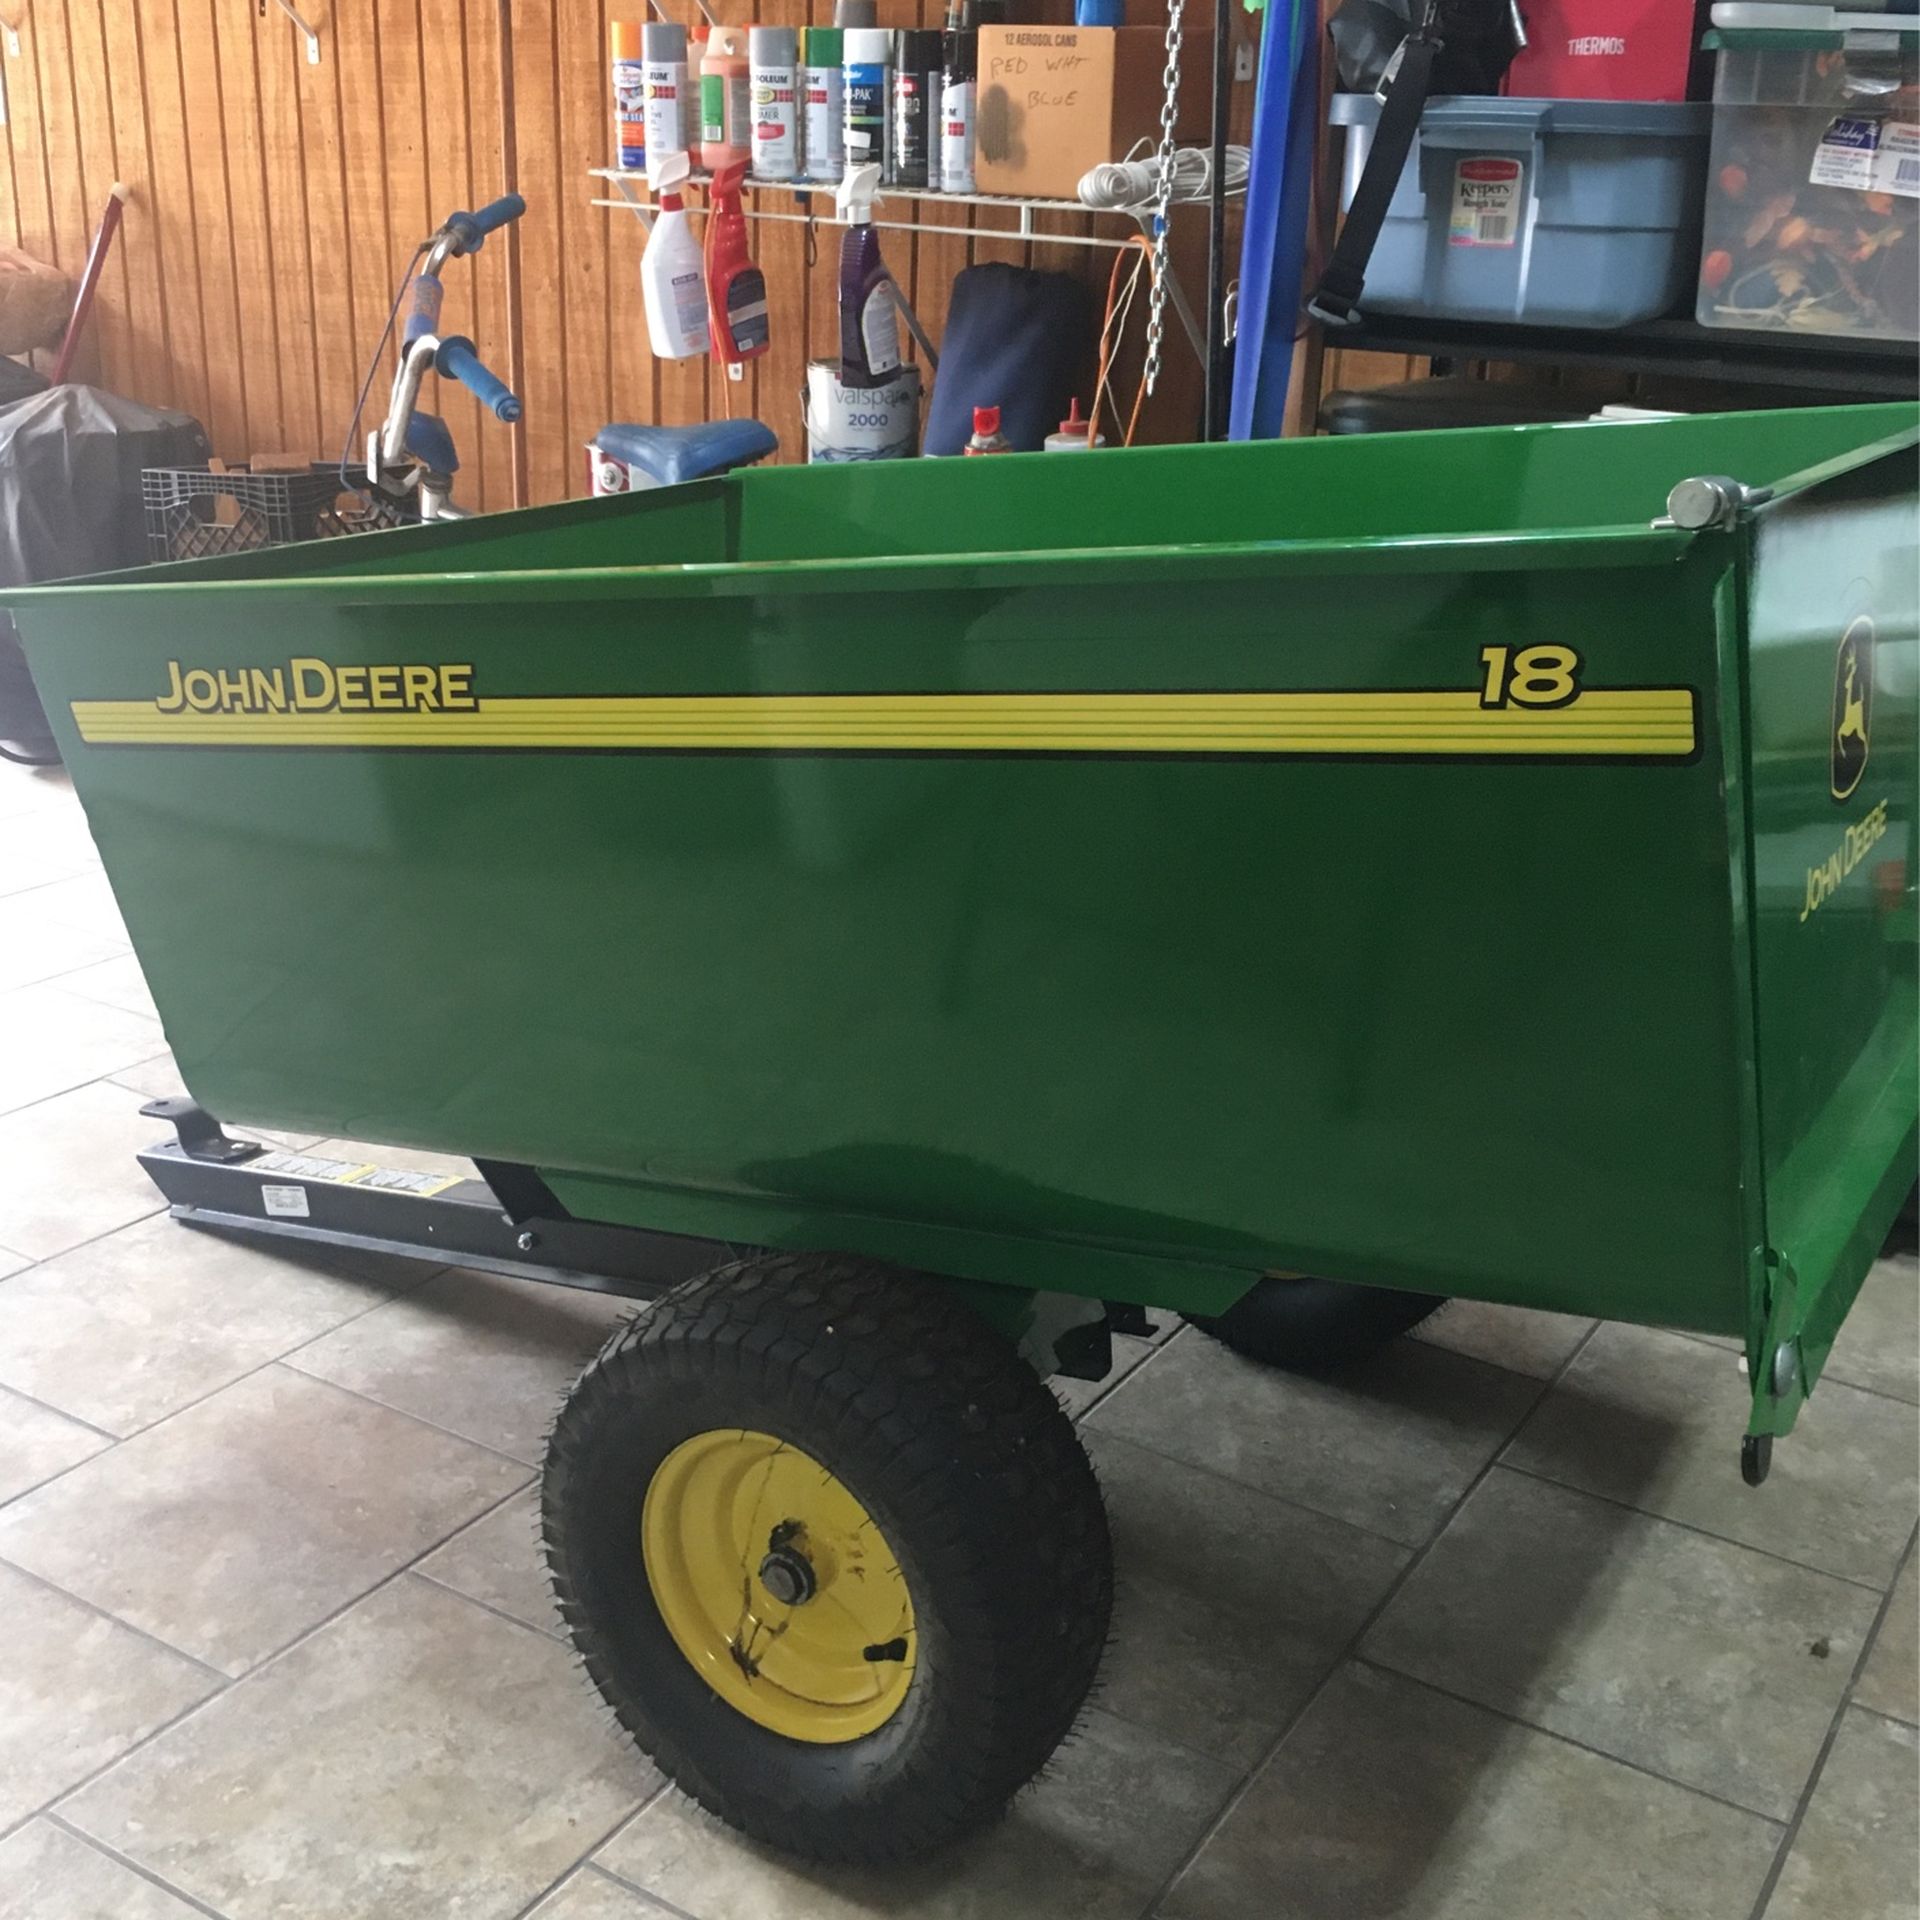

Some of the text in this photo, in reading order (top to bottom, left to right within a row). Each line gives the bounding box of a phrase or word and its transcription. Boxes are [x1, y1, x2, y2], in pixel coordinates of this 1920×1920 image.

[1005, 33, 1077, 47] 12 AEROSOL CANS
[1567, 36, 1625, 56] THERMOS
[990, 56, 1028, 79] RED
[1028, 90, 1078, 109] BLUE
[1460, 183, 1509, 198] Keepers
[848, 413, 889, 427] 2000
[156, 657, 476, 711] JOHN DEERE
[1481, 644, 1579, 704] 18
[1800, 797, 1888, 922] JOHN DEERE
